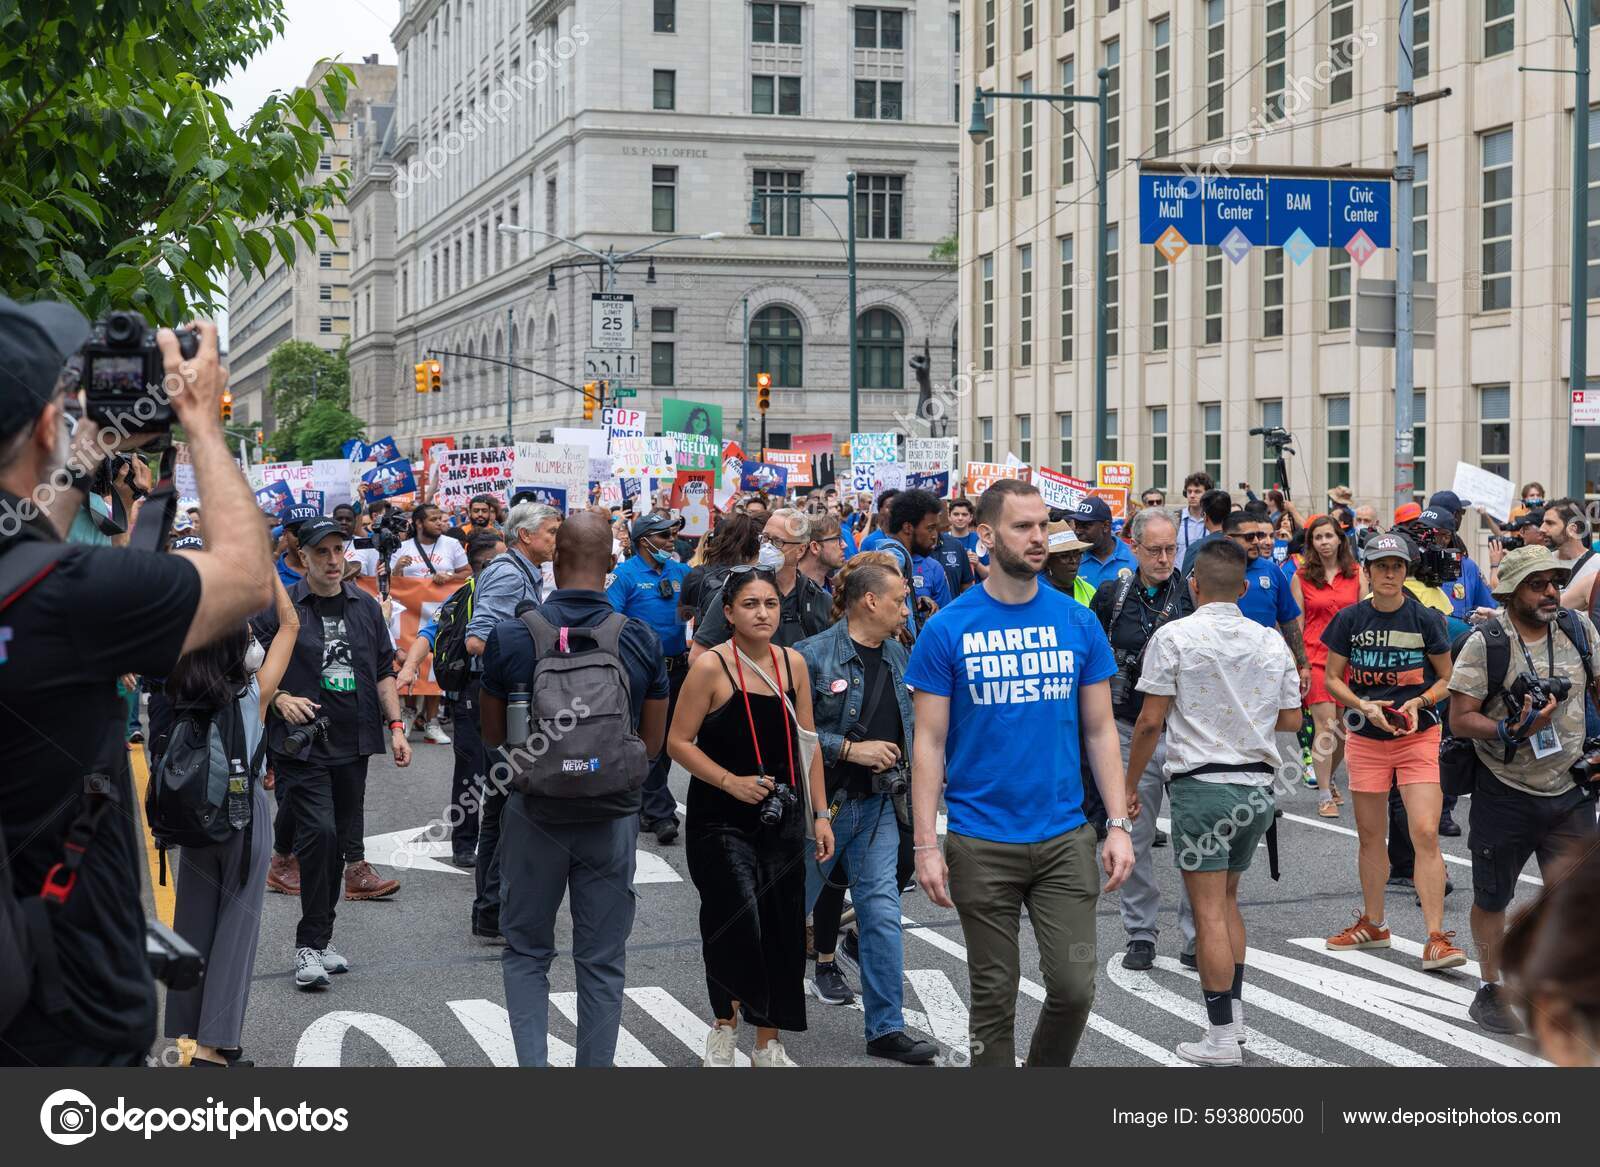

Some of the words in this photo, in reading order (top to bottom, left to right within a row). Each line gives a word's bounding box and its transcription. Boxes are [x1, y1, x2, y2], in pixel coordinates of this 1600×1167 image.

[642, 146, 668, 157] POST
[672, 148, 708, 158] OFFICE
[1153, 181, 1188, 199] Fulton
[1207, 182, 1264, 201] MetroTech
[1349, 186, 1374, 204] Civic
[1286, 193, 1311, 211] BAM
[1159, 200, 1183, 219] Mall
[1217, 202, 1253, 220] Center
[1344, 205, 1378, 223] Center
[602, 317, 623, 330] 25
[852, 434, 895, 447] PROTECT
[908, 440, 918, 449] THE
[920, 440, 933, 449] ONLY
[934, 440, 950, 449] THING
[675, 440, 719, 457] NGELLYH
[853, 447, 896, 461] KIDS
[926, 450, 933, 460] TO
[935, 450, 948, 459] BUY
[448, 452, 478, 466] THE
[481, 451, 506, 464] NRA
[674, 452, 693, 467] UNE
[697, 455, 705, 468] 8
[766, 452, 807, 463] PROTECT
[909, 461, 923, 470] THAN
[929, 461, 940, 470] GUN
[941, 461, 949, 470] IS
[970, 464, 985, 476] MY
[989, 465, 1015, 477] LIFE
[449, 469, 467, 480] HAS
[470, 467, 499, 478] BLOOD
[305, 491, 320, 499] VOTE
[445, 485, 460, 496] ON
[464, 482, 492, 494] THEIR
[291, 507, 316, 519] NYPD
[1419, 510, 1438, 520] YPD
[175, 536, 203, 548] NYPD
[963, 626, 1058, 655] MARCH
[965, 654, 1019, 681] FOR
[1021, 650, 1074, 676] OUR
[968, 678, 1040, 705] LIVES
[562, 762, 589, 771] NEWS
